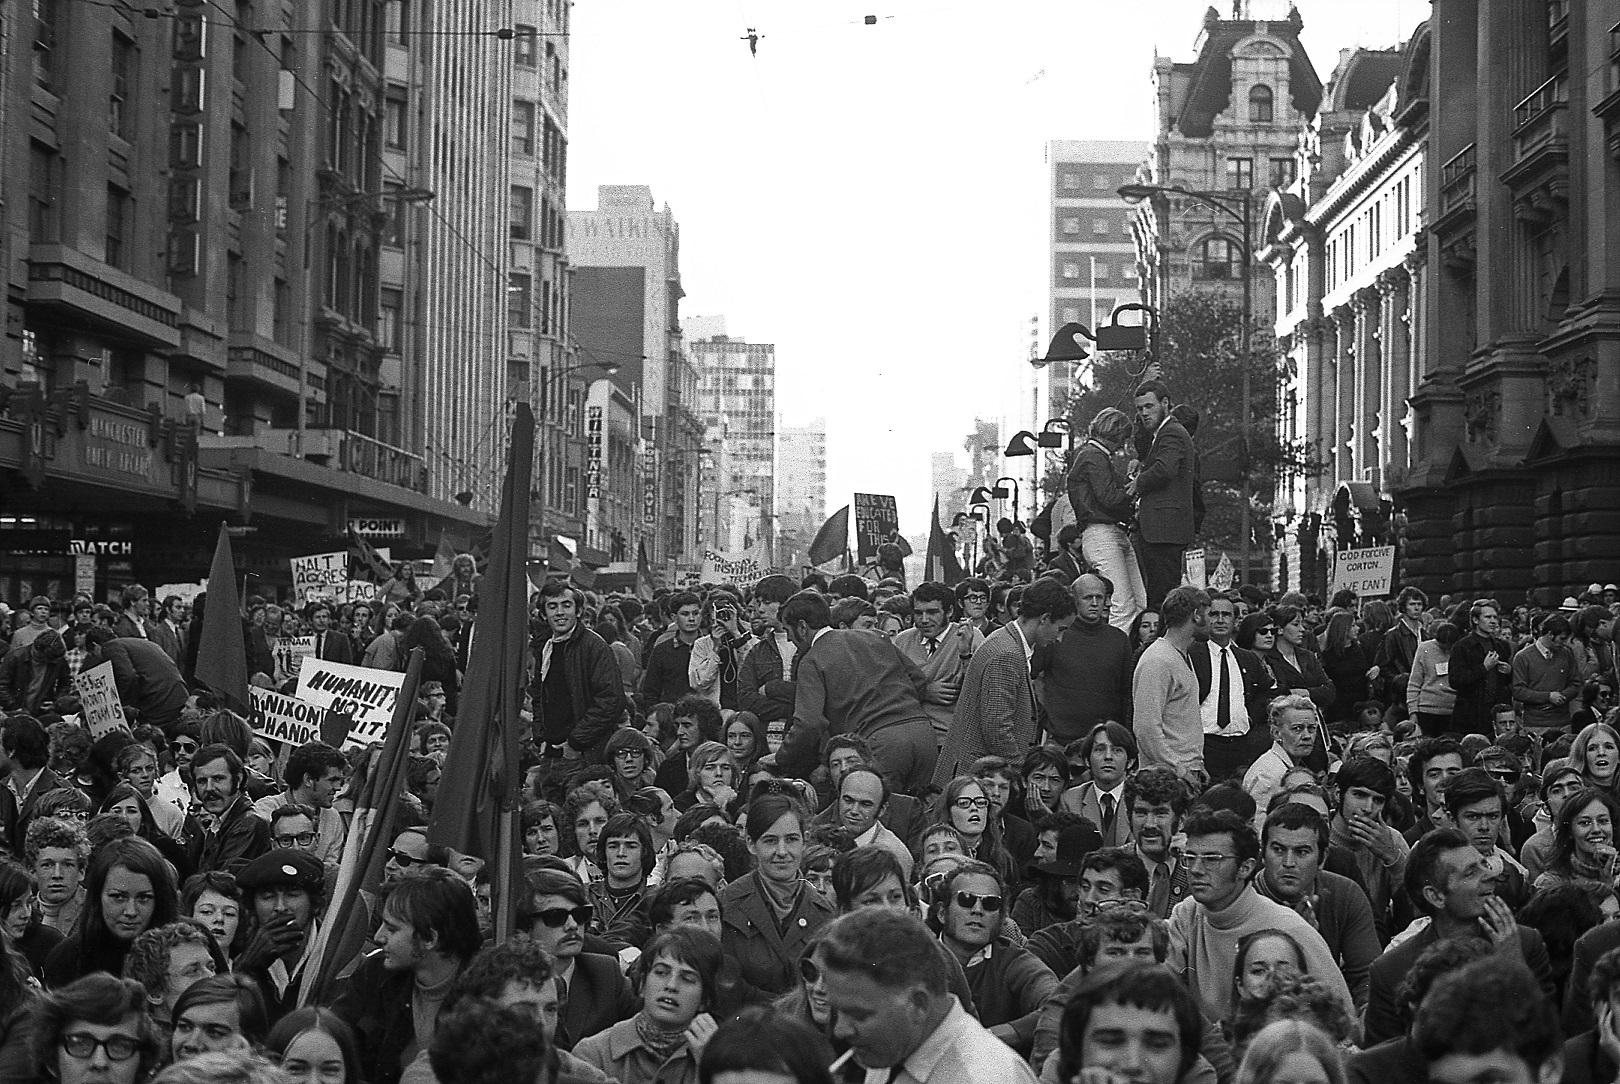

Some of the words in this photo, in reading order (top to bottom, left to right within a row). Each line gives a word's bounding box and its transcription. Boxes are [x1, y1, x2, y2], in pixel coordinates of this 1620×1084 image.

[589, 407, 602, 498] WITTNER
[645, 483, 655, 522] DAVID
[858, 520, 880, 532] FOR
[296, 555, 333, 572] HALT
[1362, 576, 1387, 591] CAN'T
[307, 670, 400, 712] HUMANITY
[110, 703, 122, 719] IS
[265, 695, 320, 726] NIXON
[331, 697, 375, 718] NOT
